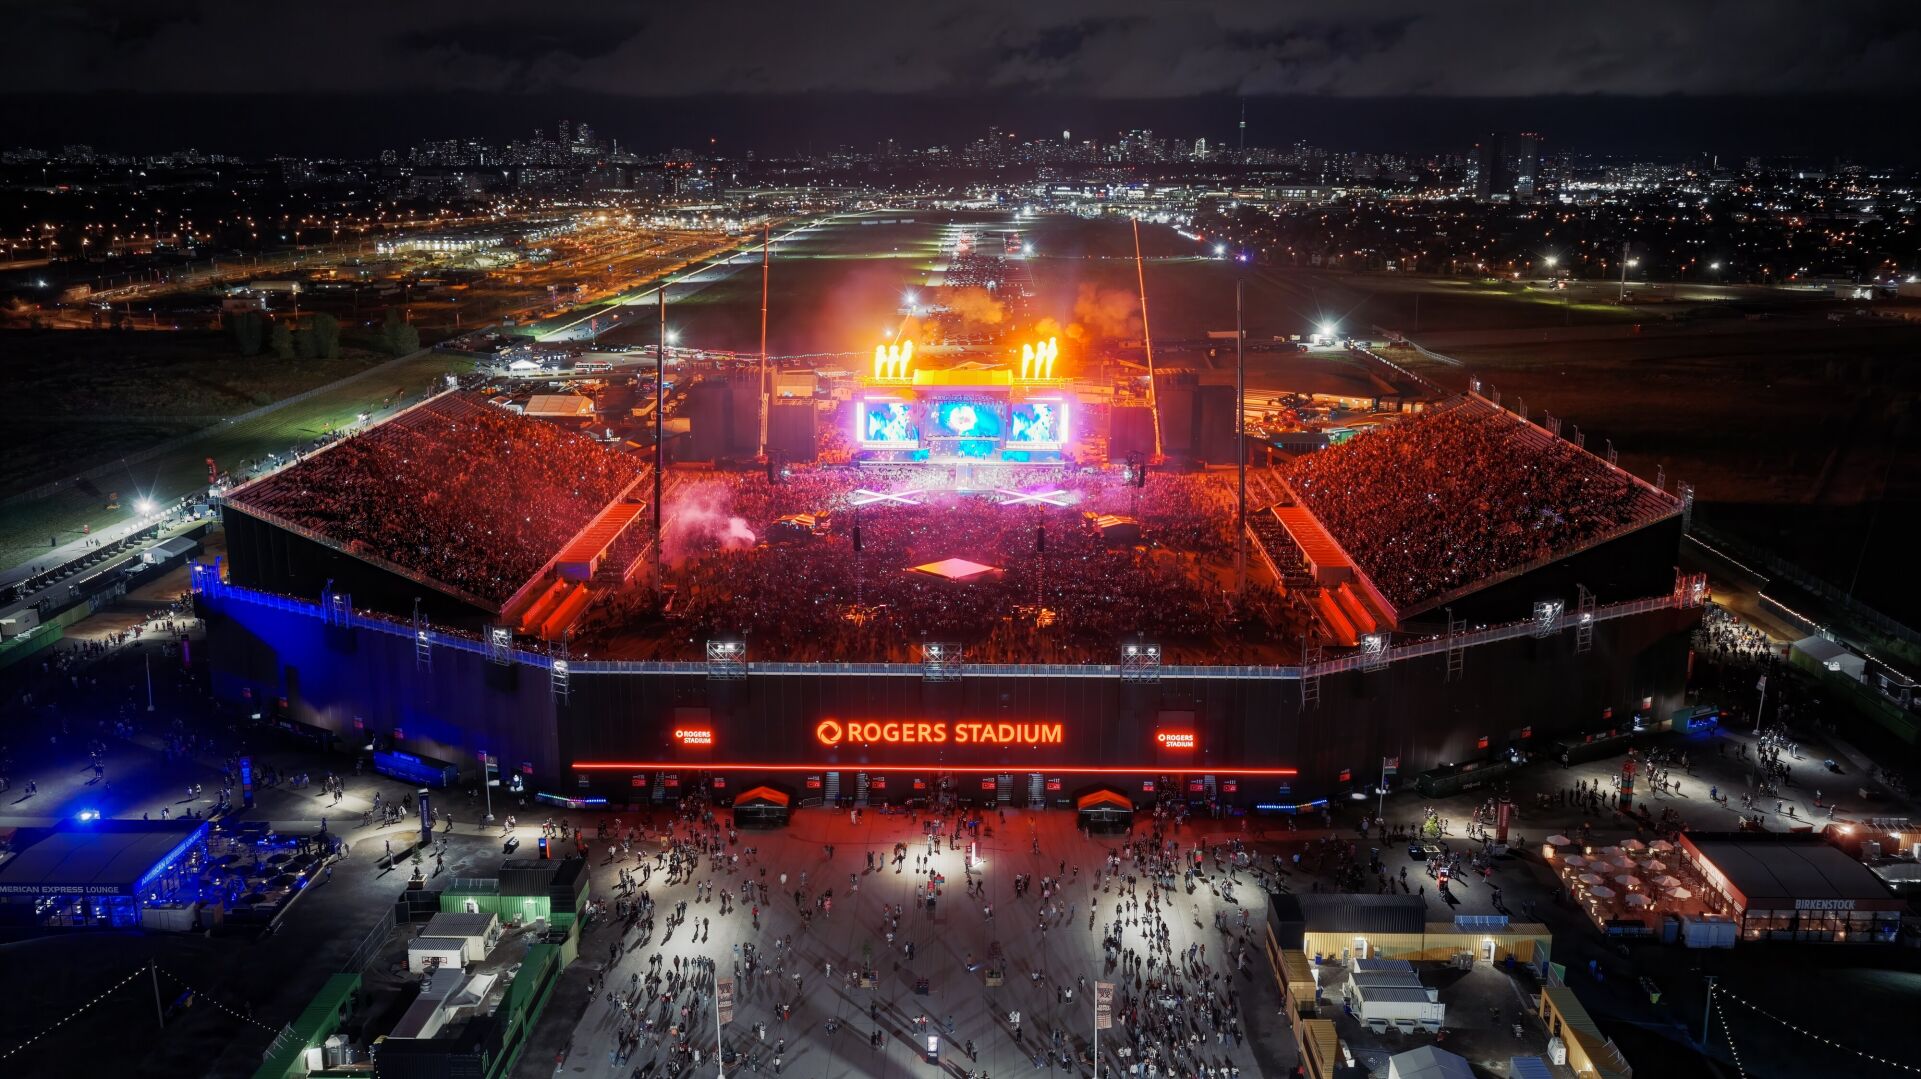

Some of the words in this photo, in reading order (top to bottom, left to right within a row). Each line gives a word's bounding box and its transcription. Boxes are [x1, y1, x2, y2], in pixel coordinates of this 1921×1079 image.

[848, 722, 946, 742] ROGERS
[955, 724, 1062, 743] STADIUM
[1795, 899, 1856, 910] BIRKENSTOCK
